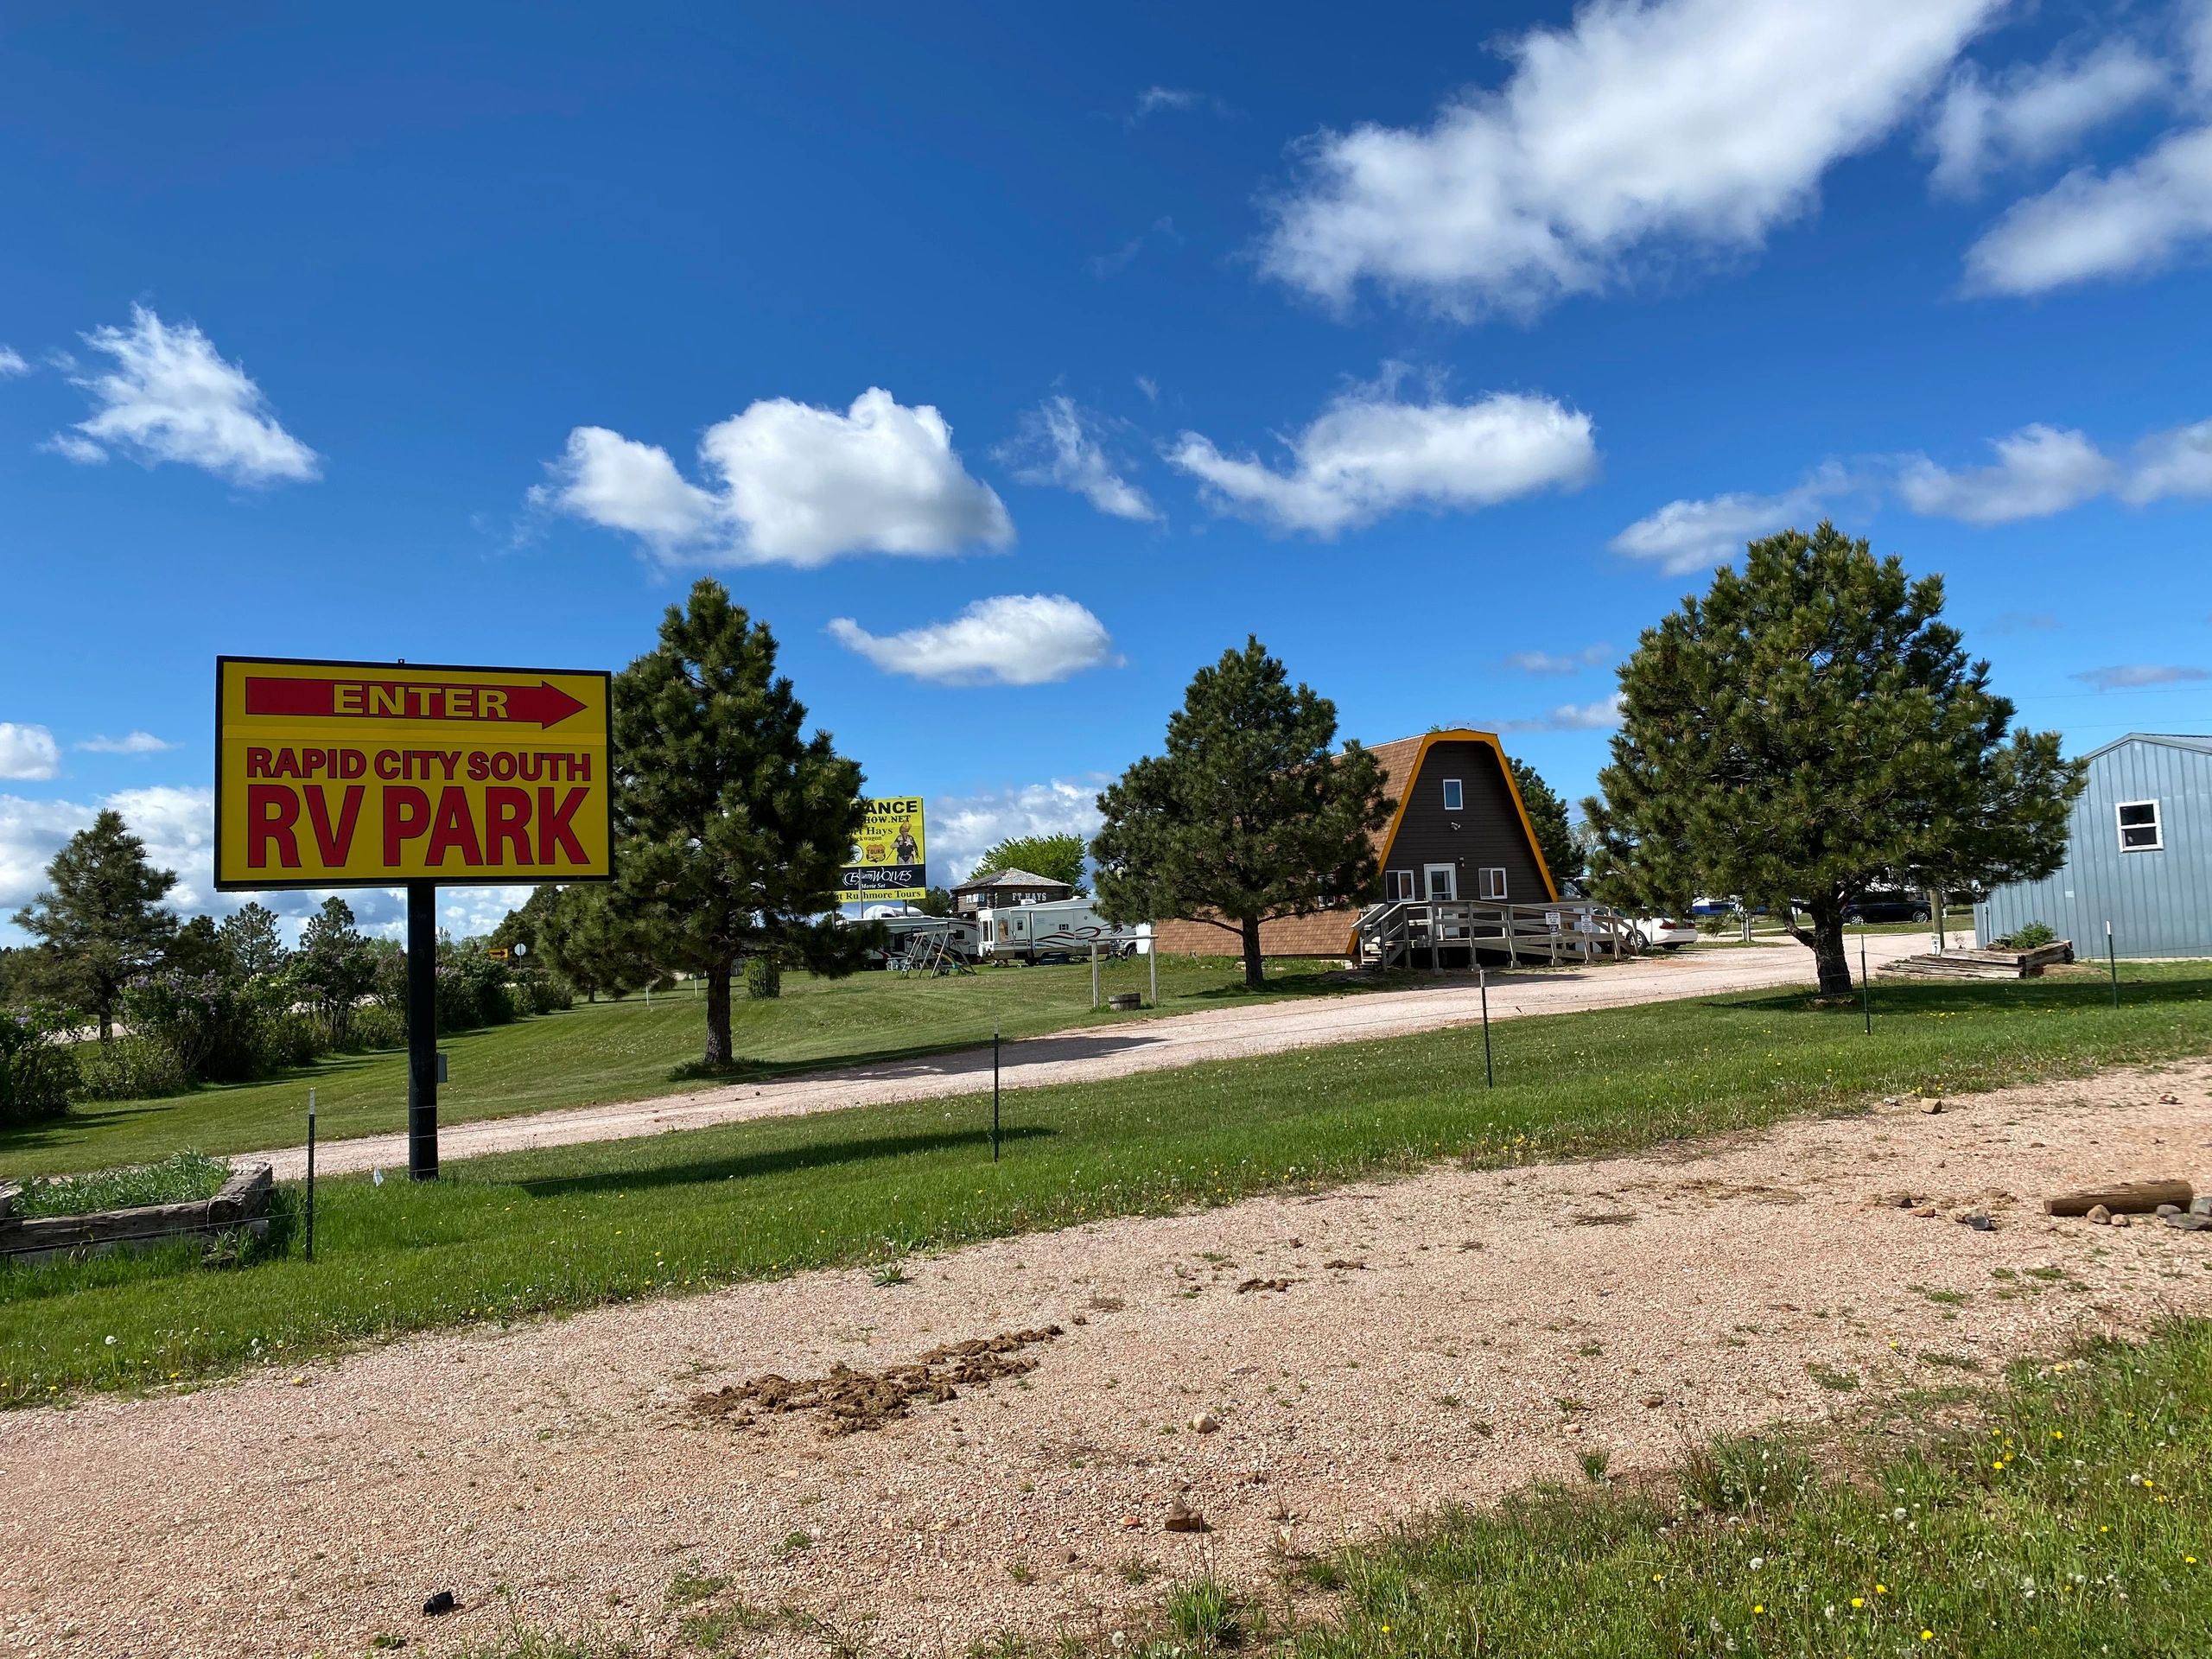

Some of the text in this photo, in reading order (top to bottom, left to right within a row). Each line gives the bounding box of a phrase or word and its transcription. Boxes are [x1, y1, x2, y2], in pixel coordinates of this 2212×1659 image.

[333, 683, 509, 719] ENTER
[247, 747, 591, 781] RAPID CITY SOUTH
[852, 800, 918, 815] ANCE
[863, 815, 912, 824] HOW.NET
[247, 785, 591, 868] RV PARK
[867, 827, 893, 836] Hays
[846, 891, 893, 899] Ruhmore
[1012, 893, 1047, 901] FT HAYS
